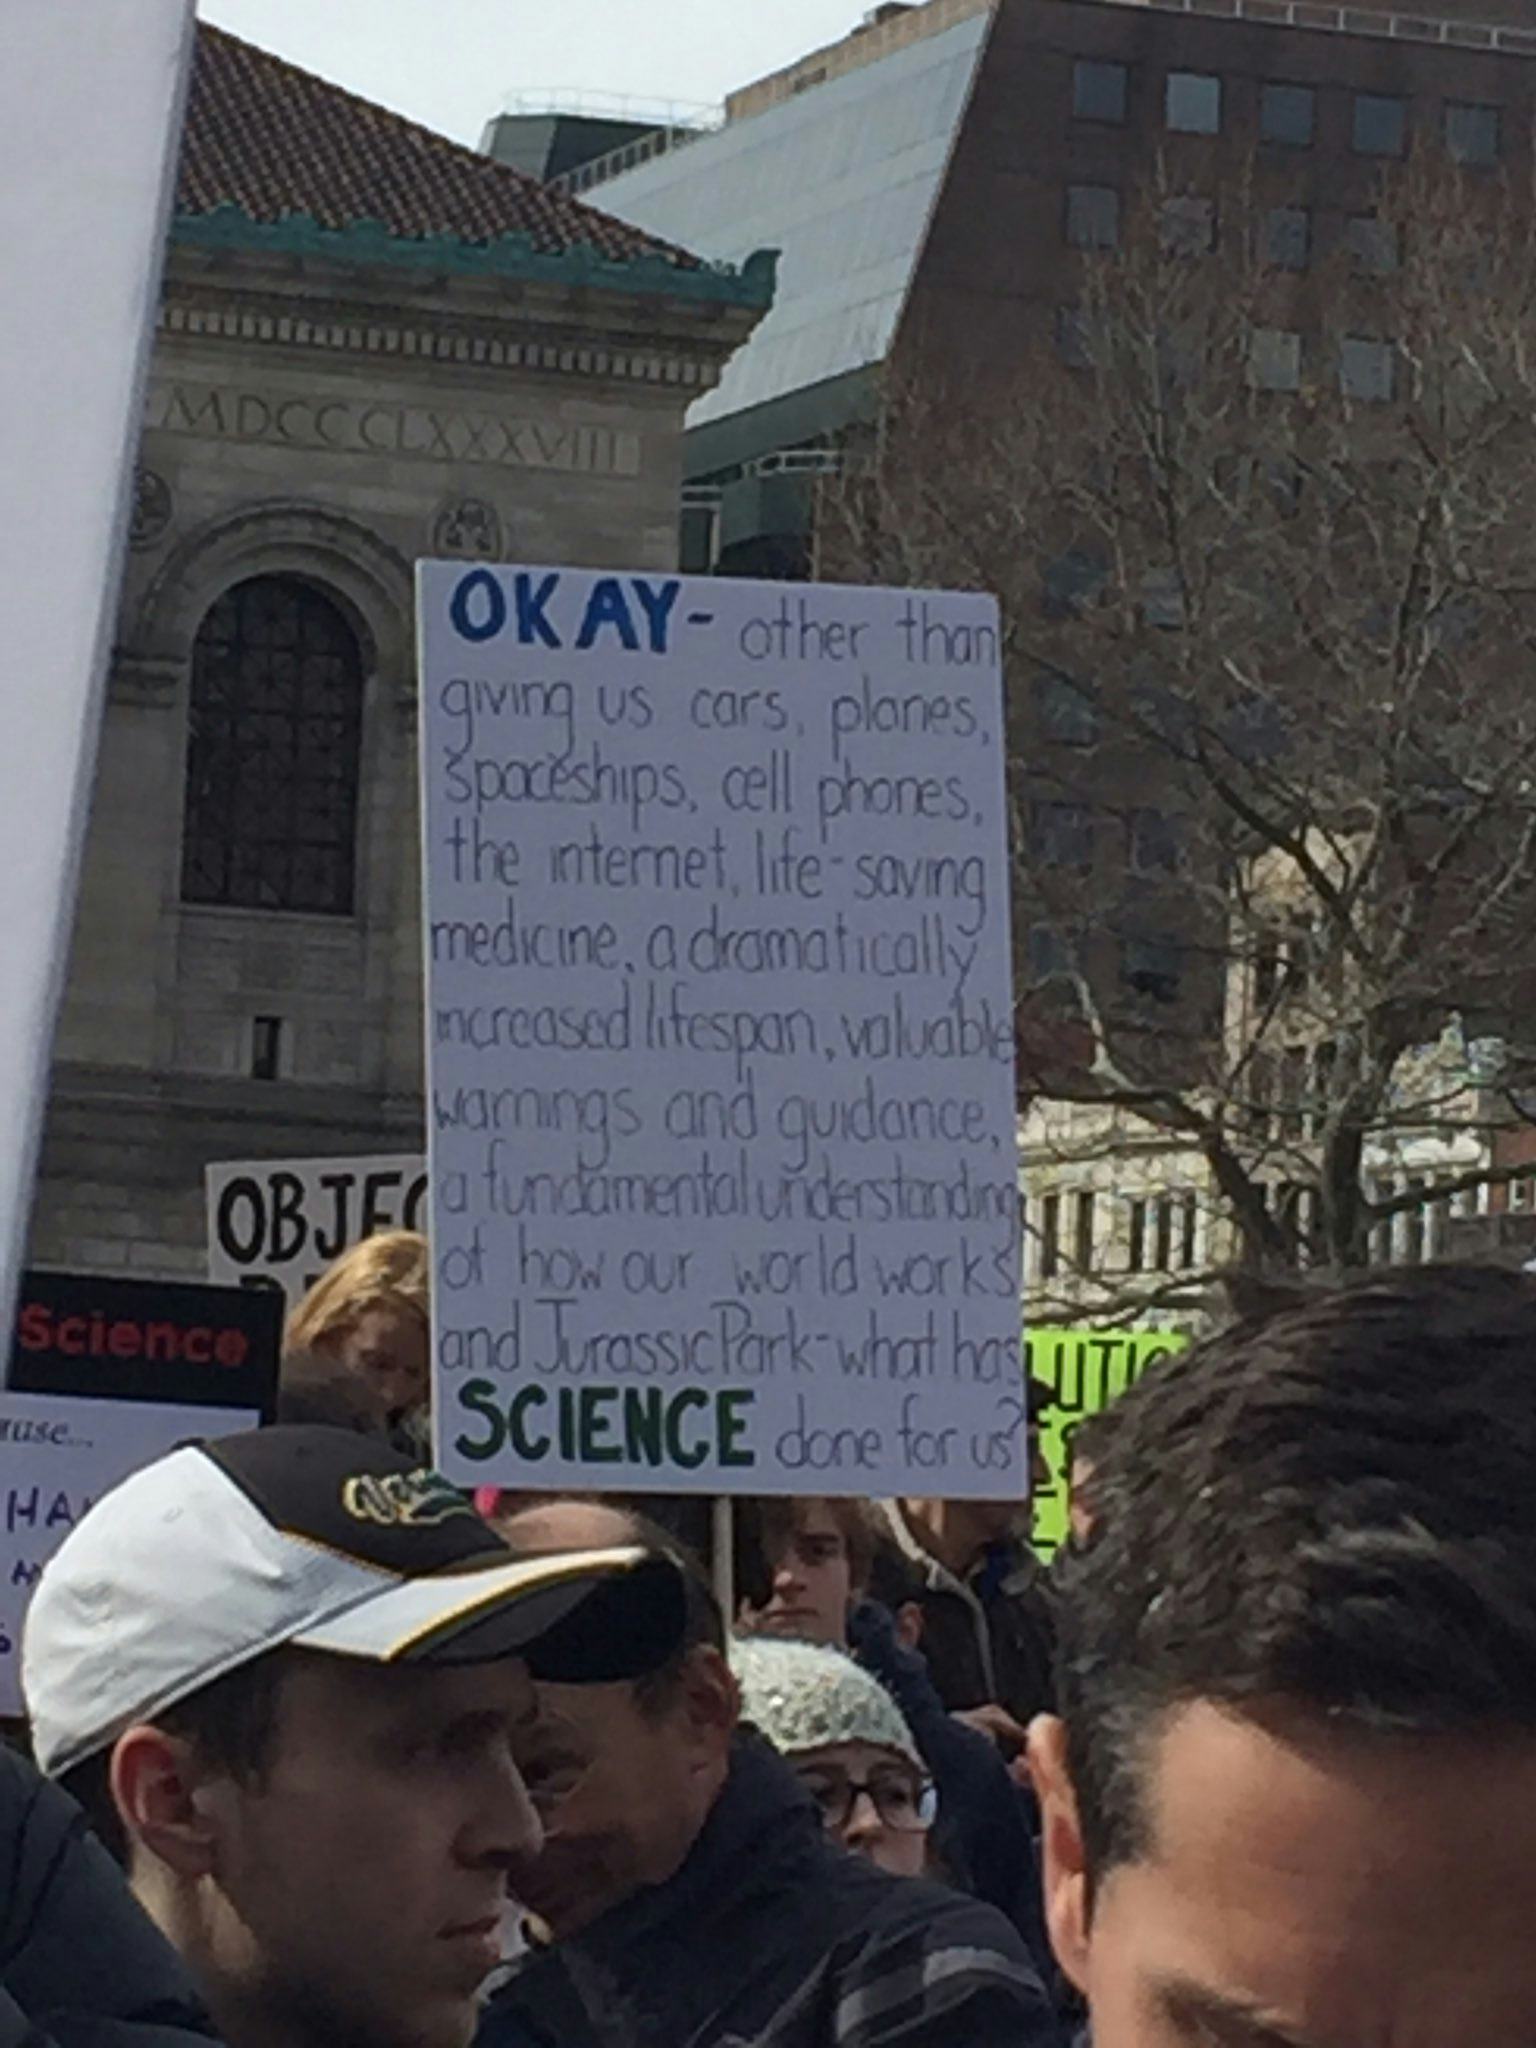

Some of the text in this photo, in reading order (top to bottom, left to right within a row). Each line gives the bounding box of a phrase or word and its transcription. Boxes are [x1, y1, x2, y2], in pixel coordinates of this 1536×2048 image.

[450, 568, 997, 667] OKAY- other than
[440, 678, 575, 758] giving
[598, 684, 652, 728] us
[831, 674, 990, 762] planes,
[722, 749, 792, 812] cell
[818, 757, 983, 844] phones,
[444, 815, 520, 887] the
[550, 821, 740, 898] internet,
[648, 924, 676, 971] a
[688, 903, 978, 1006] dramatically
[436, 978, 1014, 1083] increased lifespan, valuable
[433, 1066, 1000, 1173] warnings and guidance,
[440, 1138, 1018, 1250] a fundamental understanding
[441, 1220, 1016, 1297] of how our world works
[19, 1303, 248, 1367] Science
[439, 1299, 520, 1373] and
[533, 1298, 714, 1376] Jurassic
[953, 1310, 1019, 1386] has
[455, 1378, 755, 1469] SCIENCE
[774, 1392, 883, 1470] done
[898, 1392, 958, 1468] for
[970, 1396, 1026, 1470] us?
